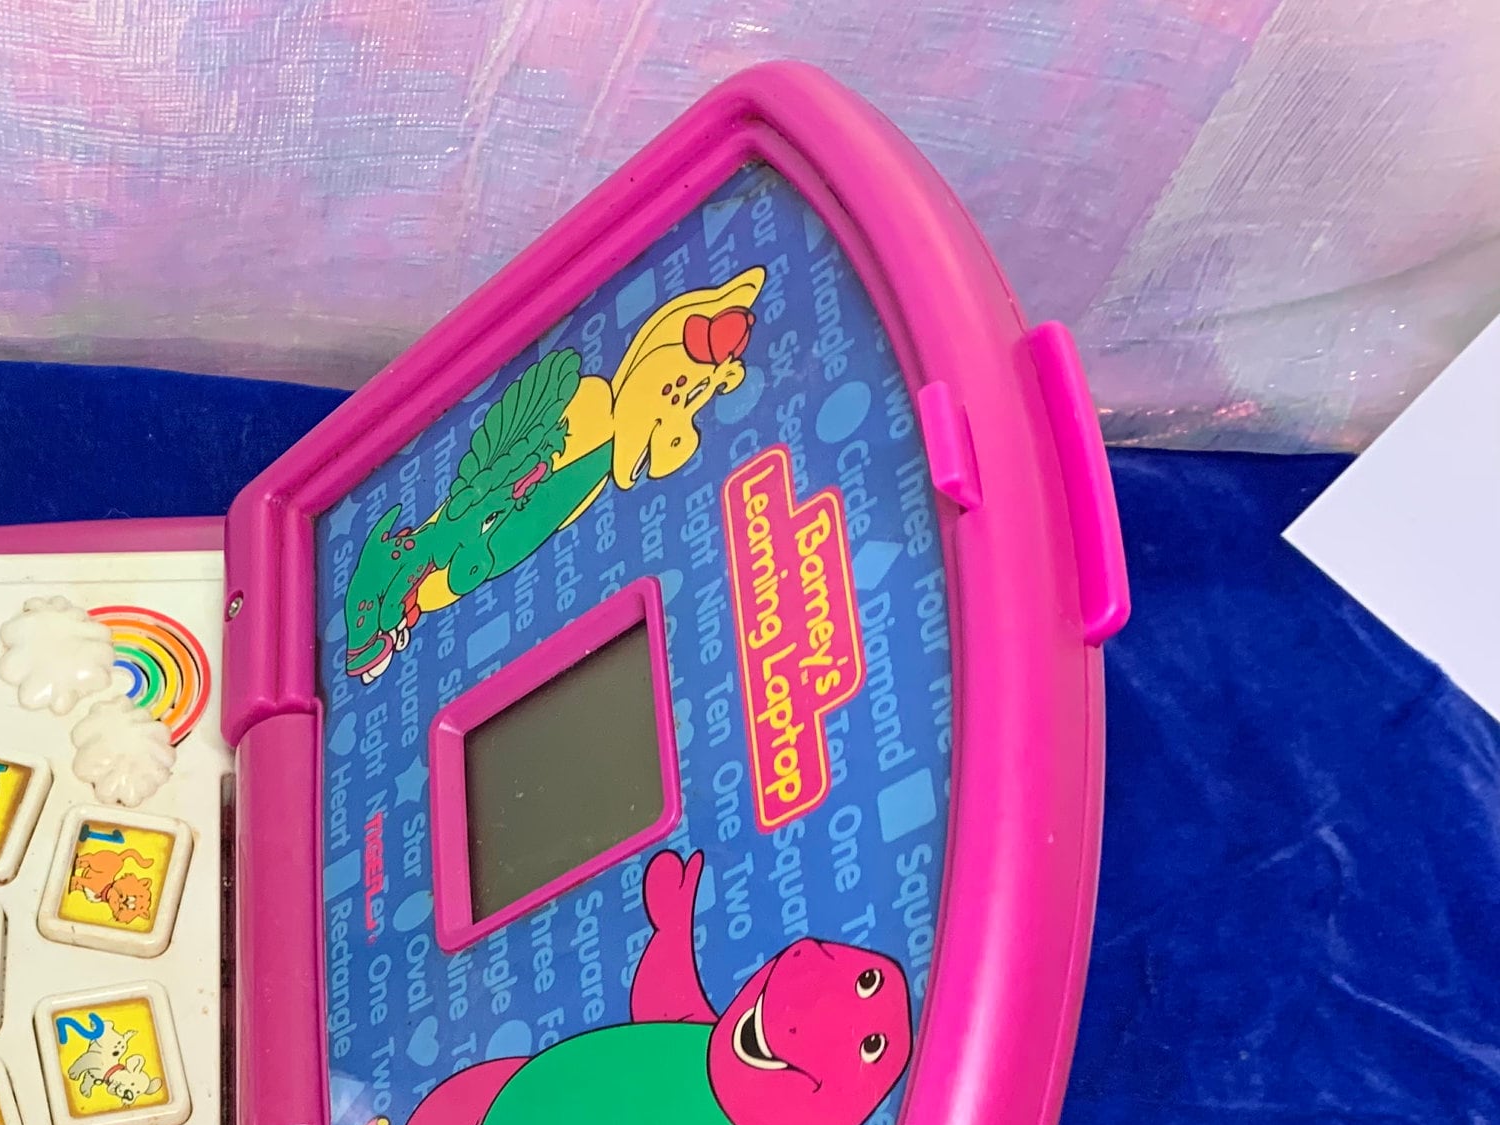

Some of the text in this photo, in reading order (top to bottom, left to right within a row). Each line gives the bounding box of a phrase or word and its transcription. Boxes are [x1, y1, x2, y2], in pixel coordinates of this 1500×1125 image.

[662, 244, 691, 300] Fiv
[761, 253, 790, 325] Five
[581, 312, 607, 374] One
[768, 330, 798, 389] Six
[366, 482, 387, 524] Fiv
[639, 494, 667, 563] Star
[680, 482, 720, 569] Eight
[333, 539, 354, 599] Star
[893, 457, 933, 559] Three
[913, 569, 948, 655] Four
[694, 577, 726, 665] Nine
[746, 464, 804, 802] Learning Laptop
[796, 509, 848, 695] Barney's
[808, 247, 933, 998] Triangle Circle Diamond Square
[331, 645, 354, 712] Oval
[704, 671, 734, 748] Ten
[360, 702, 387, 779] Eight
[395, 455, 434, 1014] Diam Square Star Oval
[825, 709, 850, 787] Ten
[330, 761, 352, 850] Heart
[513, 560, 540, 632] Nine
[530, 901, 559, 994] hree
[553, 528, 606, 1025] Circle Square
[712, 760, 744, 842] One
[79, 823, 125, 844] 1
[828, 804, 863, 893] One
[722, 851, 754, 940] Two
[768, 821, 809, 943] Squar
[327, 897, 358, 1059] Rectangle
[368, 953, 392, 1026] One
[56, 1013, 105, 1045] 2
[451, 1032, 477, 1073] Te
[369, 1036, 395, 1113] Two
